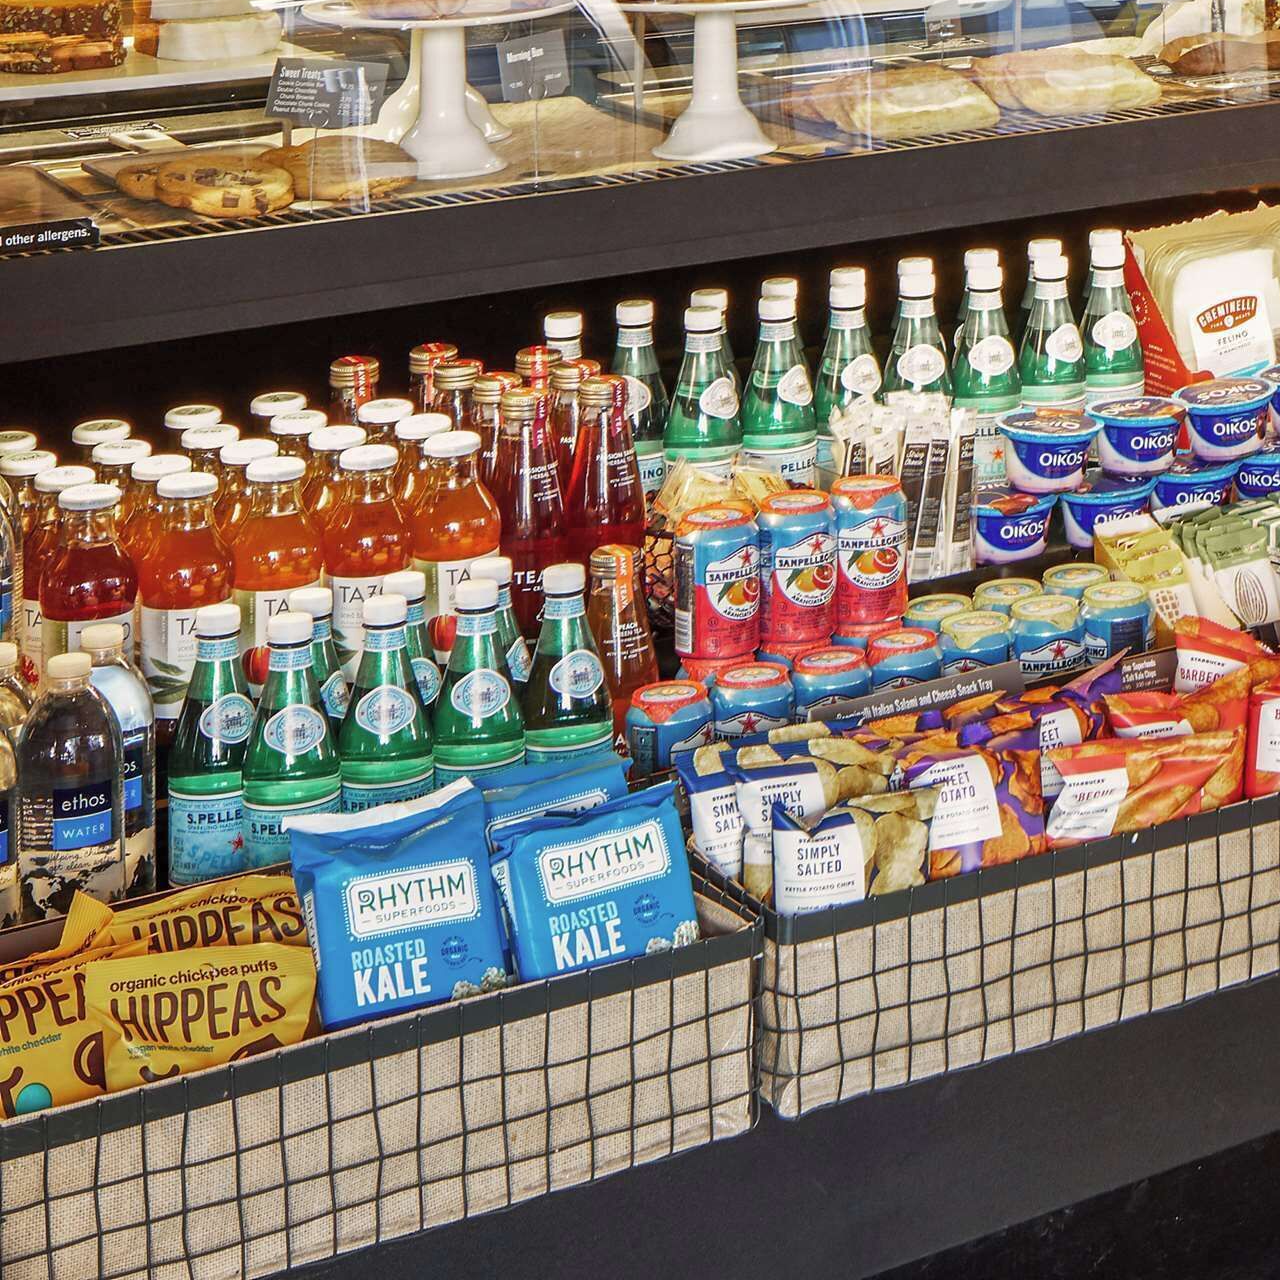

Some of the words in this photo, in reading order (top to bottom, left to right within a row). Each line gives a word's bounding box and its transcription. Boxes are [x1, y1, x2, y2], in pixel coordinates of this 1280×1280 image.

[4, 233, 35, 246] other
[37, 229, 91, 243] allergens.
[1198, 297, 1256, 327] CREMINELLI
[1212, 419, 1257, 435] OIKOS
[1130, 434, 1173, 451] OIKOS
[1039, 451, 1083, 467] OIKOS
[61, 791, 107, 813] ethos
[62, 823, 106, 840] WATER
[550, 833, 655, 882] RHYTHM
[797, 844, 841, 861] SIMPLY
[797, 860, 842, 876] SALTED
[358, 872, 467, 915] RHYTHM
[376, 901, 456, 923] SUPERFOODS
[549, 900, 618, 932] ROASTED
[351, 939, 426, 970] ROASTED
[551, 918, 626, 970] KALE
[110, 973, 167, 993] organic
[169, 966, 238, 985] chickpea
[241, 960, 278, 978] puffs
[354, 957, 431, 1008] KALE
[110, 975, 287, 1044] HIPPEAS
